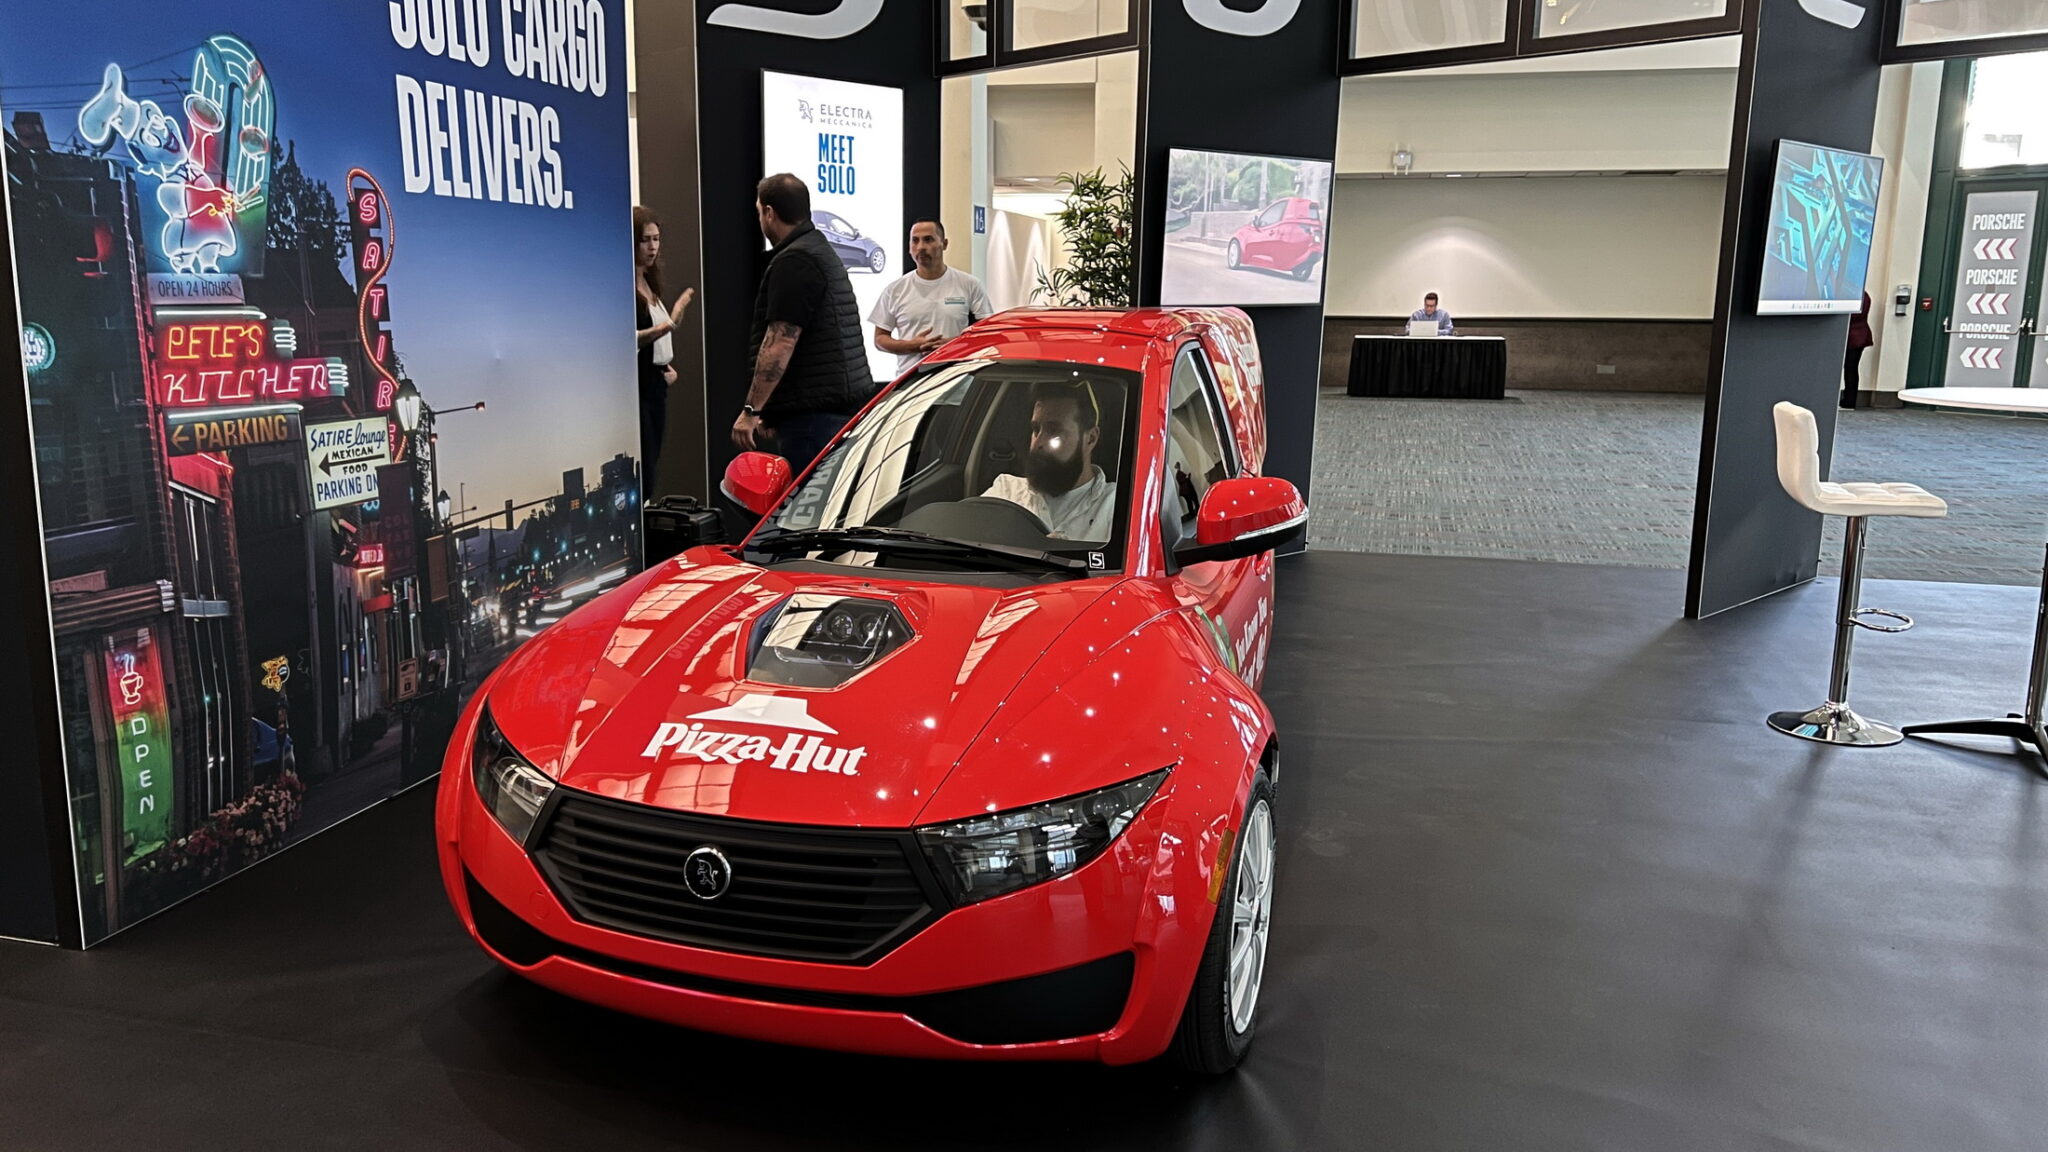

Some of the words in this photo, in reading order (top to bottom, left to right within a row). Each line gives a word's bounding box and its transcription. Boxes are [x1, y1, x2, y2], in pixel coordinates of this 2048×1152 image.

[501, 0, 607, 97] CARGO
[820, 103, 872, 120] ELECTRA
[820, 118, 872, 128] MECCANICA
[396, 74, 573, 209] DELIVERS.
[818, 132, 855, 165] MEET
[817, 163, 855, 195] SOLO
[1972, 213, 2026, 231] PORSCHE
[158, 281, 184, 297] OPEN
[186, 281, 199, 297] 24
[201, 281, 233, 297] HOURS
[1965, 268, 2019, 286] PORSCHE
[167, 325, 263, 360] PETE'S
[1958, 322, 2012, 340] PORSCHE
[194, 414, 288, 448] PARKING
[310, 428, 353, 452] SATIRE
[347, 422, 386, 450] lounge
[331, 446, 374, 460] MEXICAN
[342, 463, 368, 476] FOOD
[316, 476, 362, 502] PARKING
[641, 722, 771, 765] Pizza
[769, 732, 868, 776] Hut
